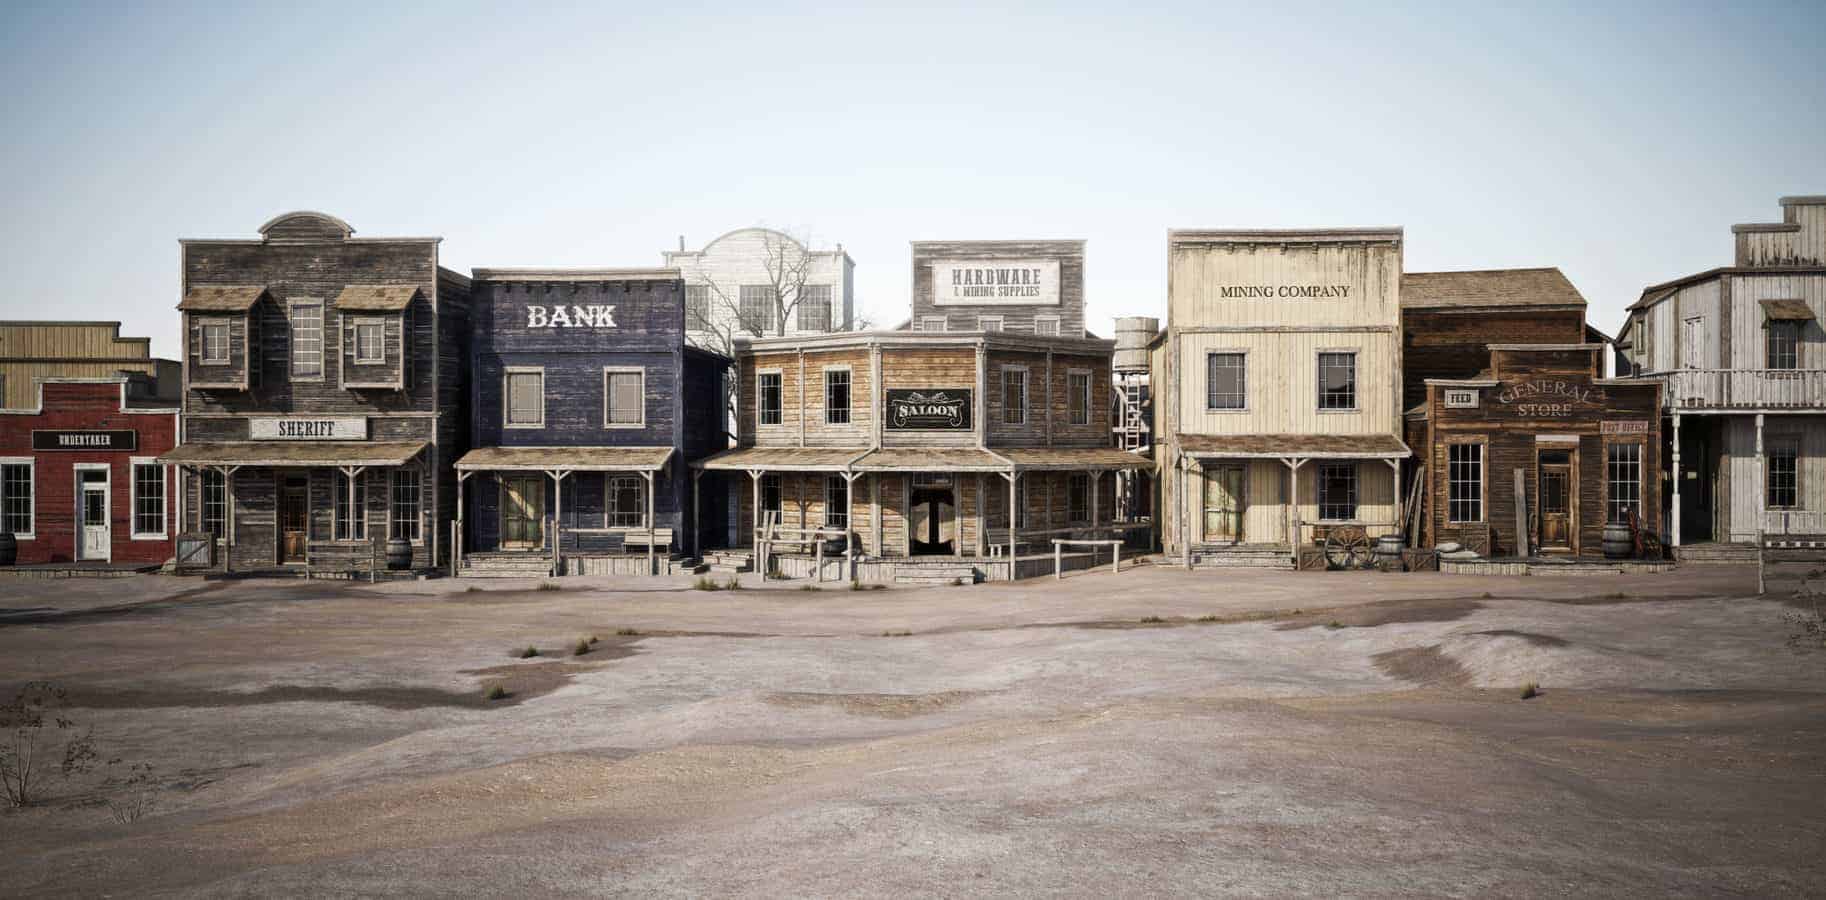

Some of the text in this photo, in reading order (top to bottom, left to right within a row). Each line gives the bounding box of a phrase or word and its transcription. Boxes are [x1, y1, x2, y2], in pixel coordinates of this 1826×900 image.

[952, 268, 1041, 286] HARDWARE
[963, 286, 995, 297] MINING
[998, 286, 1040, 297] SUPPLIES
[1220, 285, 1351, 298] MINING COMPANY
[527, 305, 617, 328] BANK
[1499, 380, 1599, 404] GENERAL
[899, 405, 958, 418] SALOON
[1518, 403, 1572, 417] STORE
[279, 421, 335, 437] SHERIFF
[59, 435, 111, 446] UNDERTAKER
